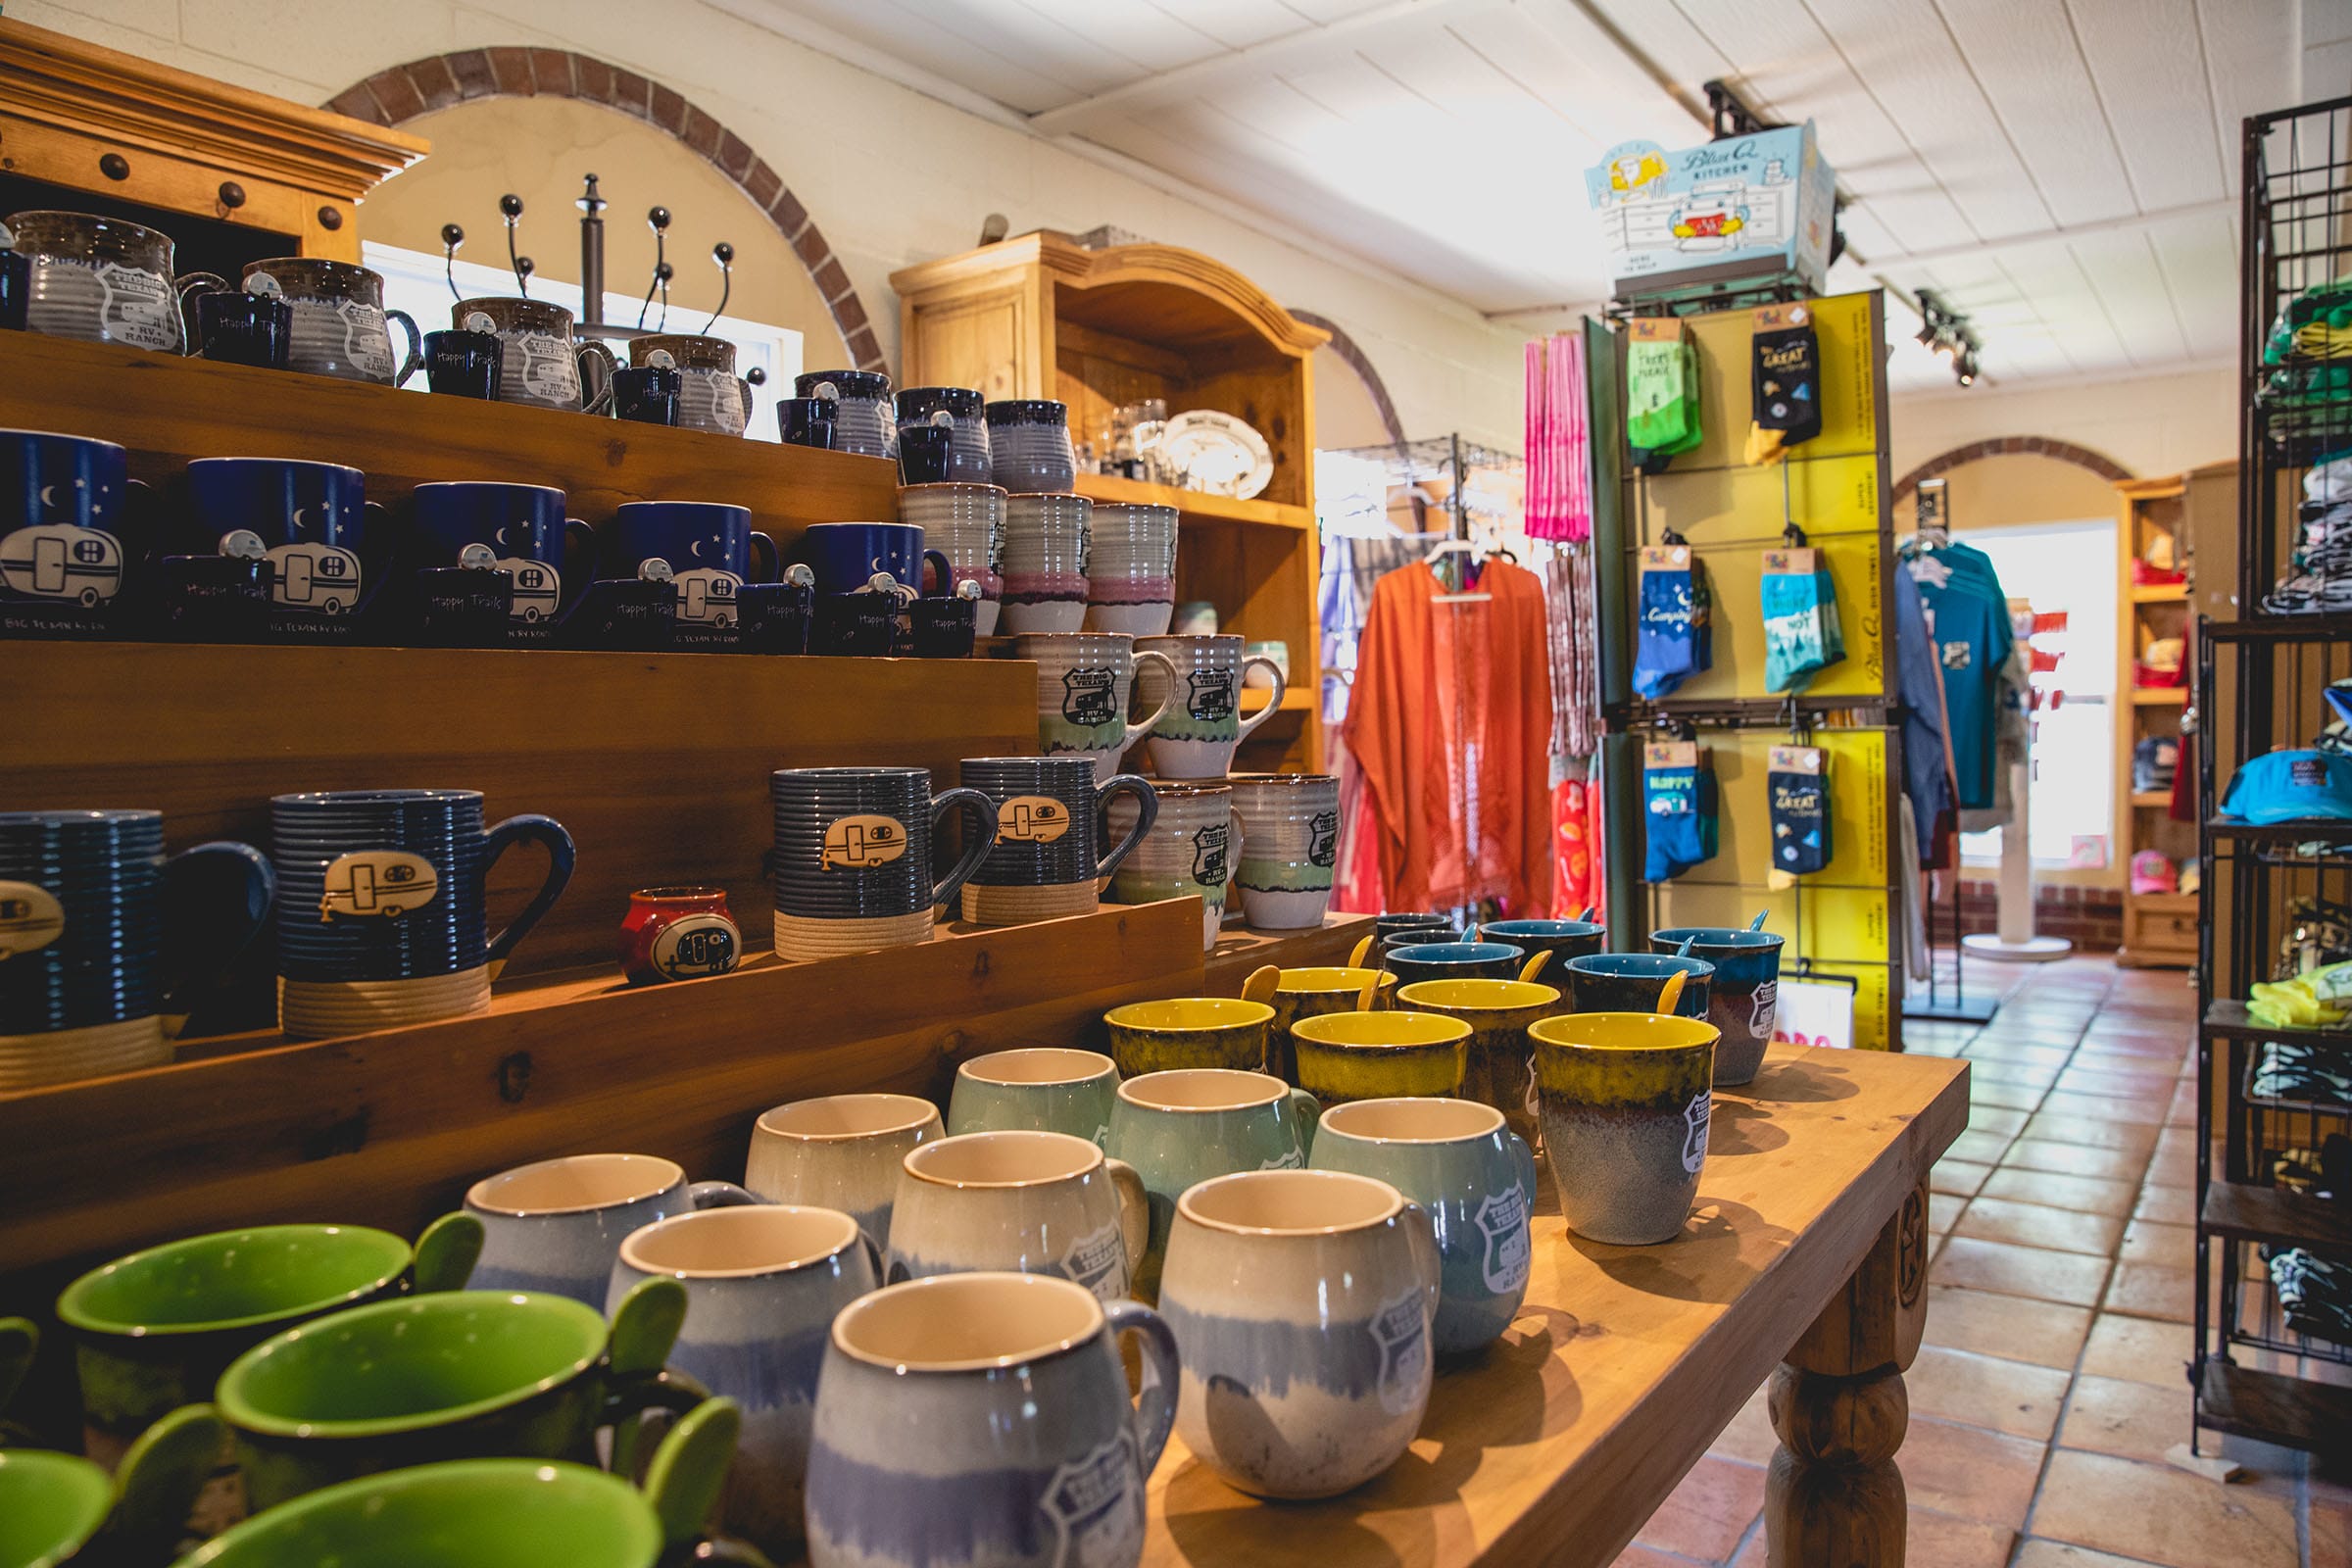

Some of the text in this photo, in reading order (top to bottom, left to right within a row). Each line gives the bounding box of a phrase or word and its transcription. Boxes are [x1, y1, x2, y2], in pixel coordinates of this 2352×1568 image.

[1680, 139, 1760, 172] Blue Q
[1693, 164, 1748, 179] KITCHEN
[139, 326, 156, 335] RV
[125, 332, 166, 346] RANCH
[437, 352, 465, 367] Happy
[1763, 346, 1808, 369] GREAT
[540, 388, 569, 399] RANCH
[431, 594, 502, 612] Happy Trails
[616, 603, 647, 618] Happy
[766, 604, 795, 619] Happy
[1647, 607, 1692, 624] Camping
[858, 614, 884, 628] Happy
[931, 618, 956, 631] Happy
[1649, 775, 1694, 790] HAPPY
[1775, 795, 1819, 810] GREAT
[1490, 1201, 1509, 1218] THE
